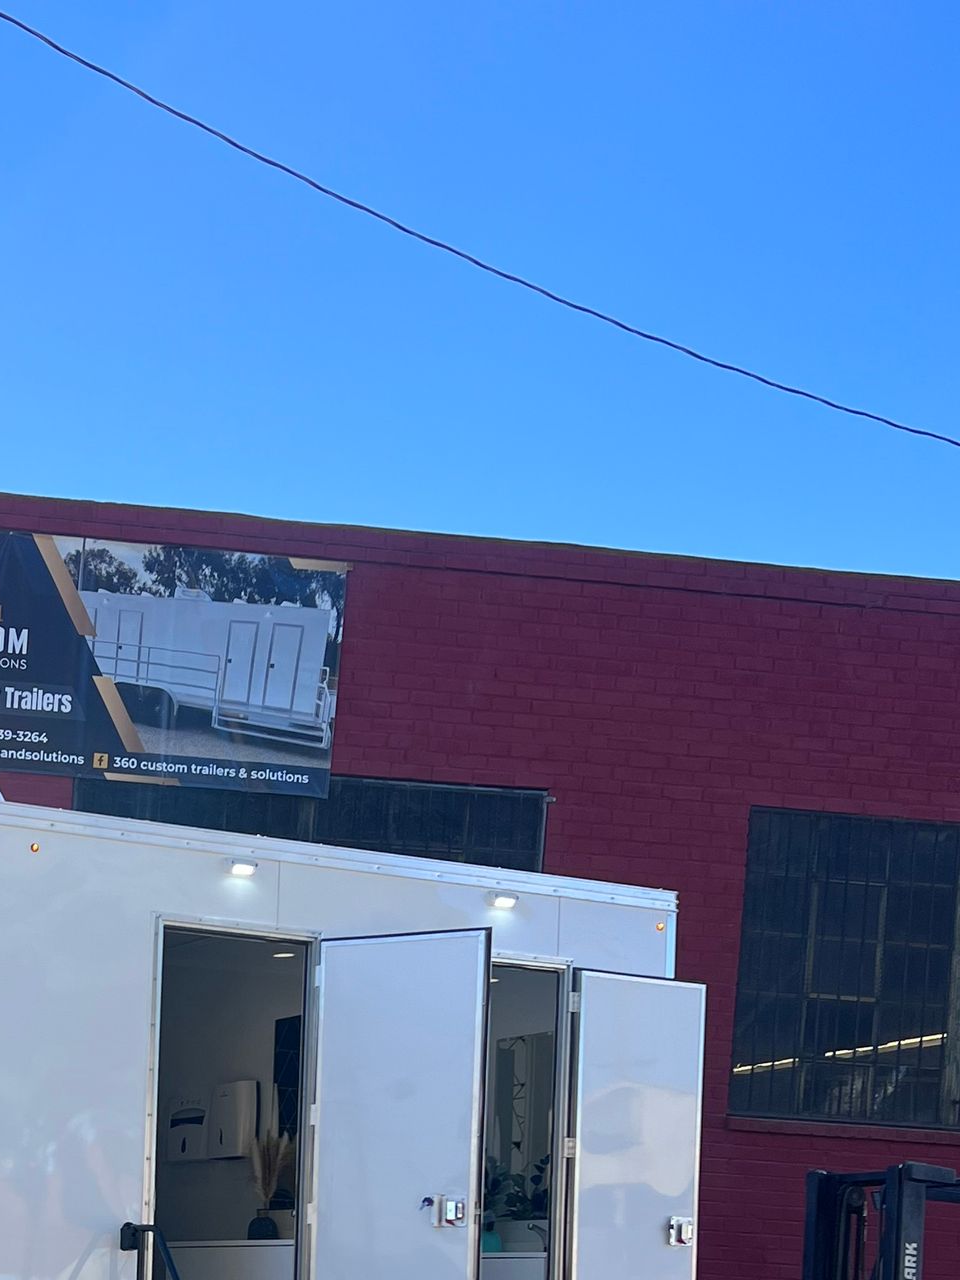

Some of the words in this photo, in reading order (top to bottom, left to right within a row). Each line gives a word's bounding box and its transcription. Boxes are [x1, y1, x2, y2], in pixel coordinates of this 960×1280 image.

[5, 687, 72, 714] Trailers
[113, 756, 138, 769] 360
[140, 760, 188, 774] custom
[190, 763, 237, 778] trailers
[238, 767, 248, 778] &
[250, 768, 310, 784] solutions
